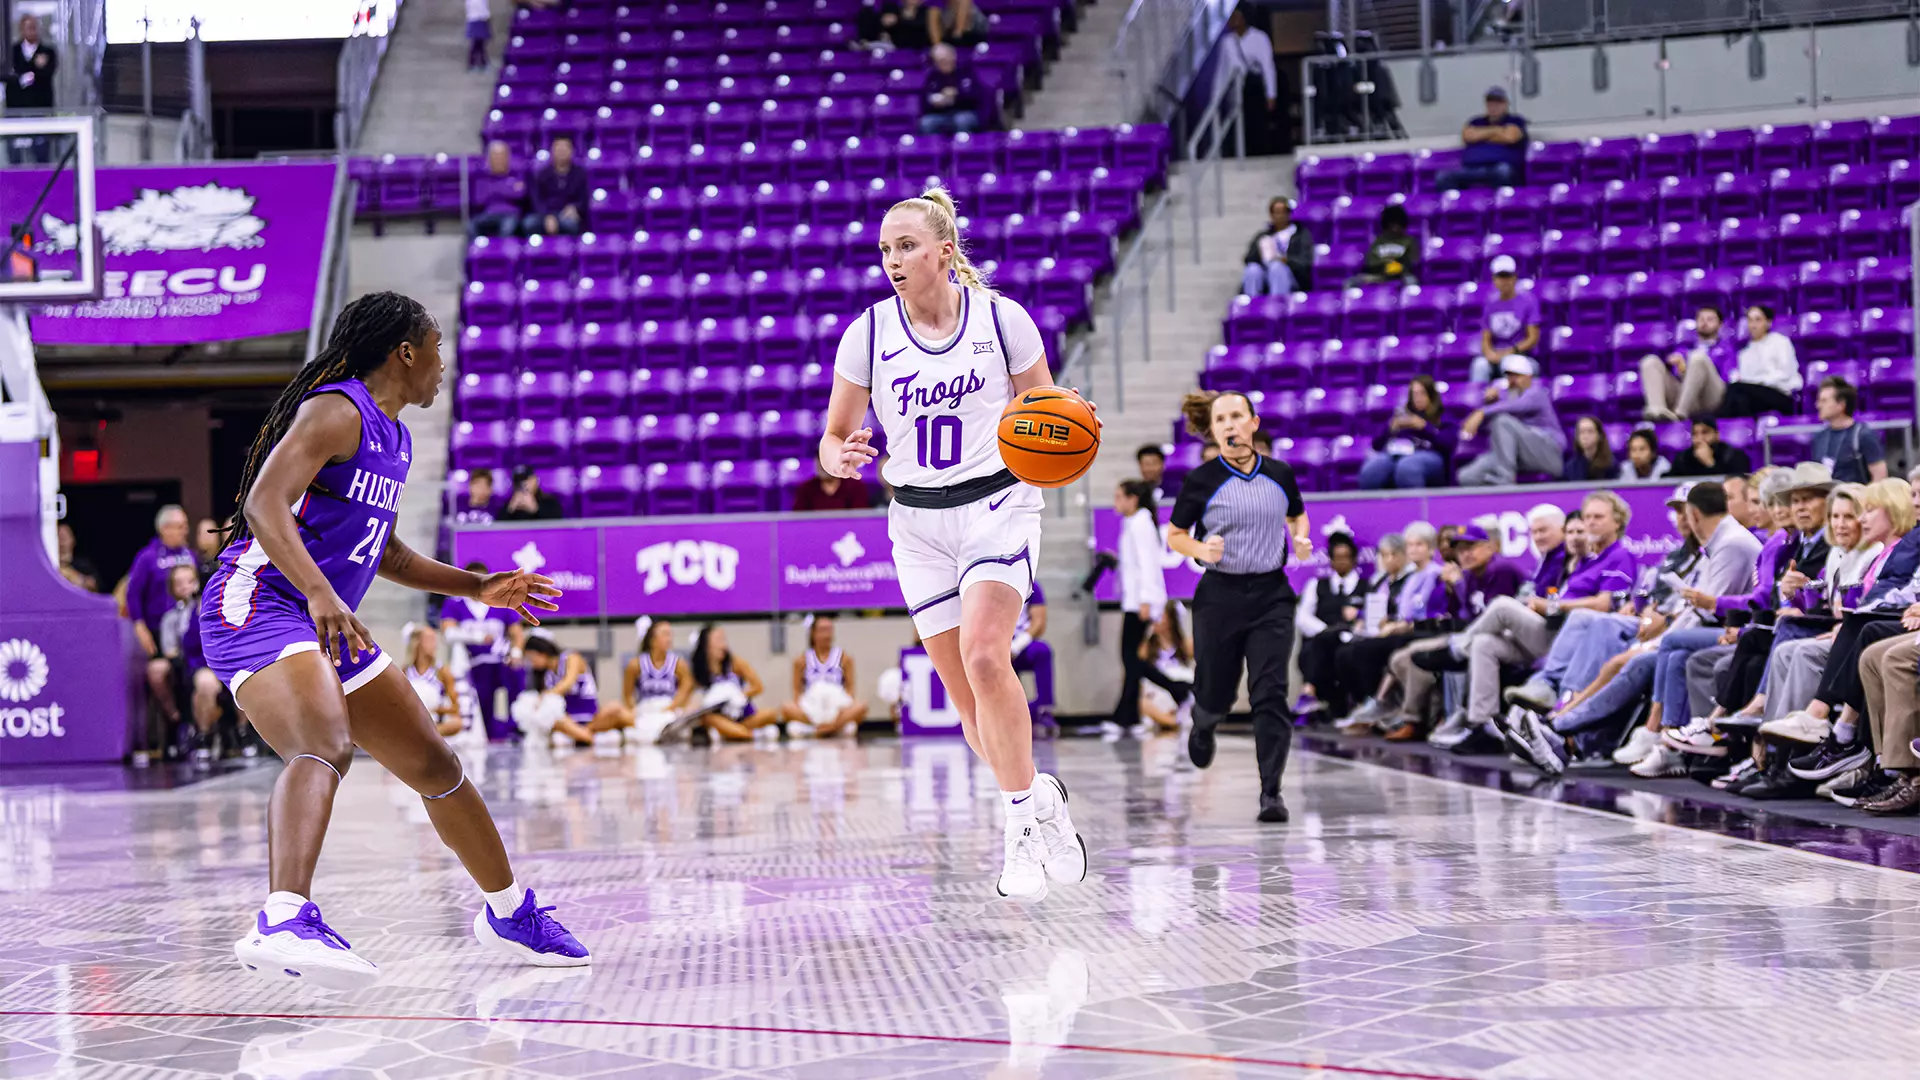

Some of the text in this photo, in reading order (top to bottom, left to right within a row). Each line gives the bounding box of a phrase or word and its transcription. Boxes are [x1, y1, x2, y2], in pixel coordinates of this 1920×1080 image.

[891, 368, 985, 416] Frogs
[915, 415, 963, 470] 10
[1013, 419, 1070, 441] ELITE
[348, 516, 389, 568] 24
[636, 539, 740, 596] TCU
